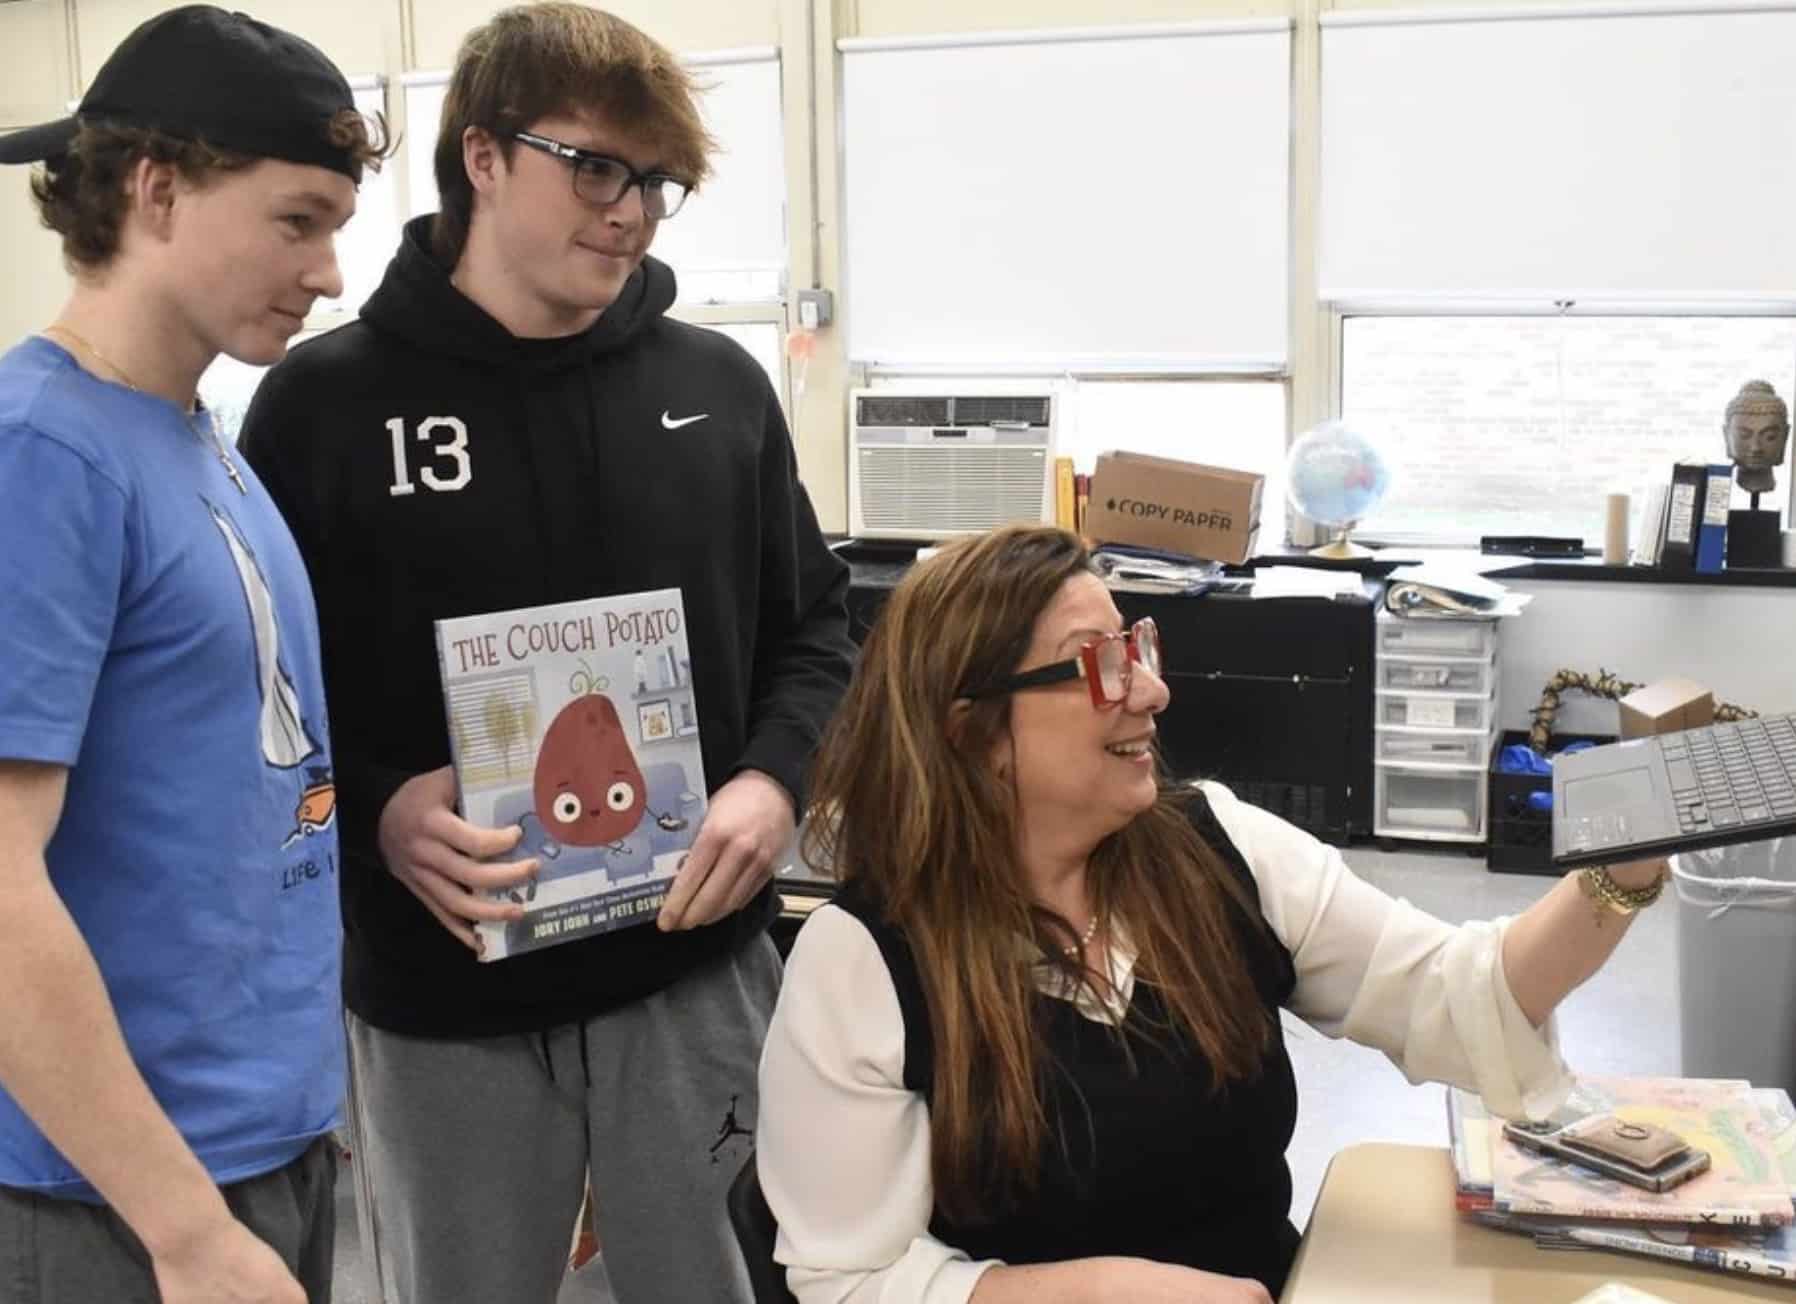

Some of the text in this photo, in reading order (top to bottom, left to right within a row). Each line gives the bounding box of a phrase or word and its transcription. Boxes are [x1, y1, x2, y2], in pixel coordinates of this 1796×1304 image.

[385, 416, 472, 495] 13
[1118, 498, 1170, 519] COPY
[1173, 507, 1232, 531] PAPER
[453, 633, 501, 673] THE
[507, 615, 596, 660] COUCH
